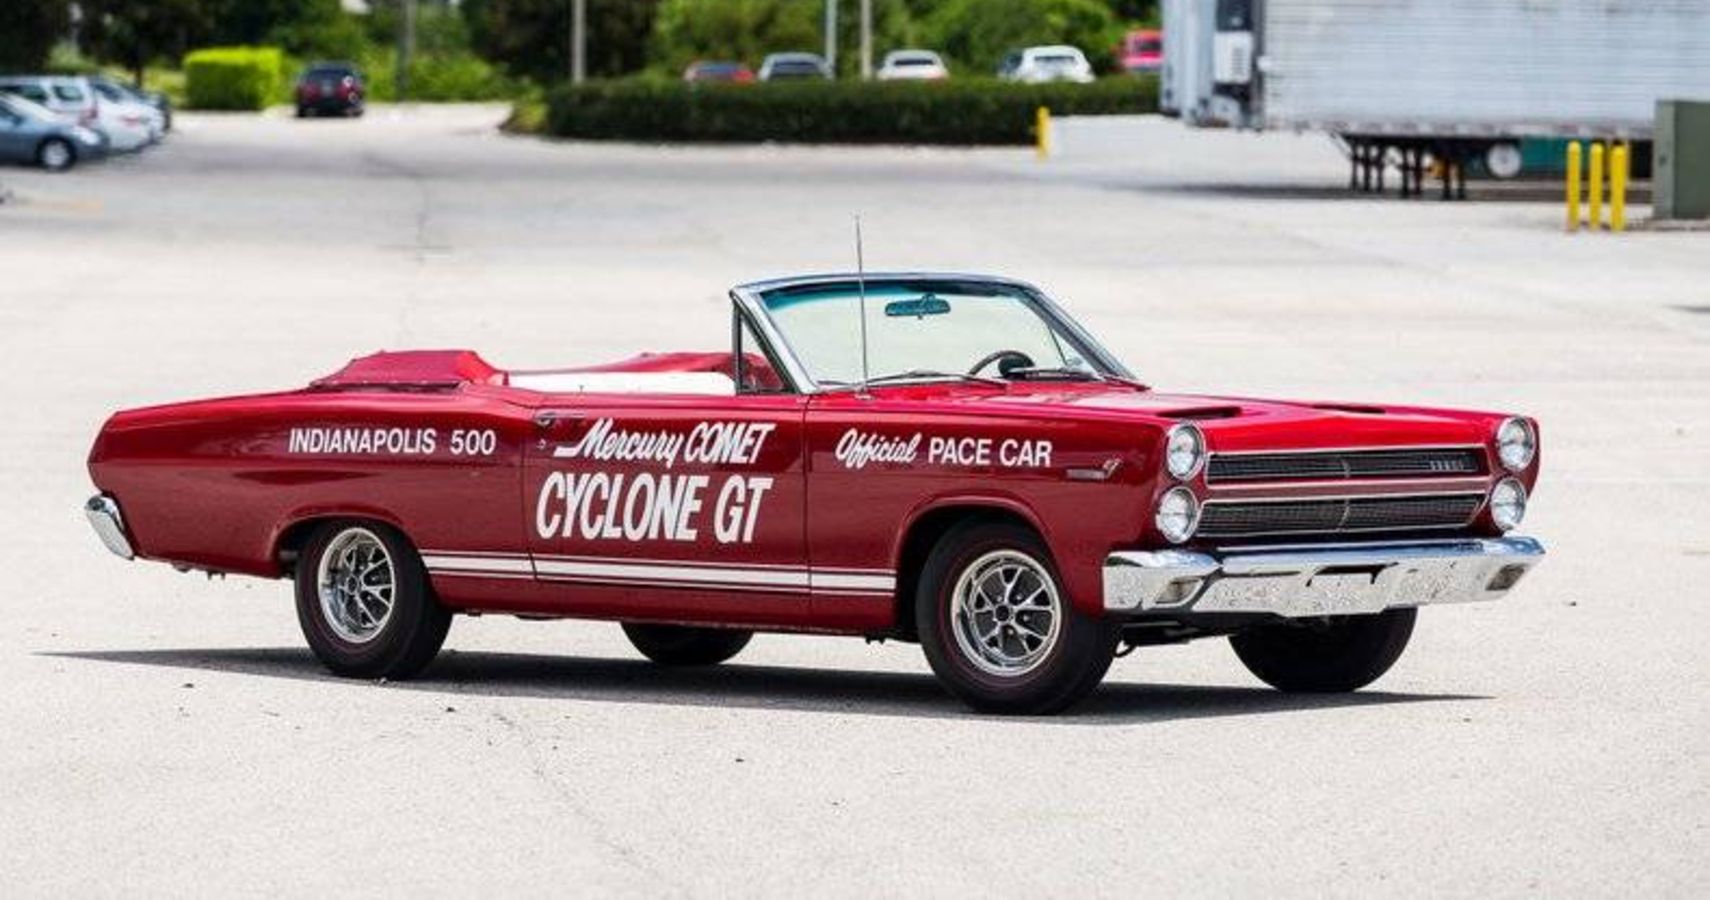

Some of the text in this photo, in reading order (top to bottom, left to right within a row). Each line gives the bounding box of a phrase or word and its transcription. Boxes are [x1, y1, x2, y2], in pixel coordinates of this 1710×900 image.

[288, 428, 496, 456] INDIANAPOLIS 500
[554, 418, 777, 467] Mercury COMET
[836, 428, 1052, 467] Official PACE CAR
[535, 472, 775, 543] CYCLONE GT
